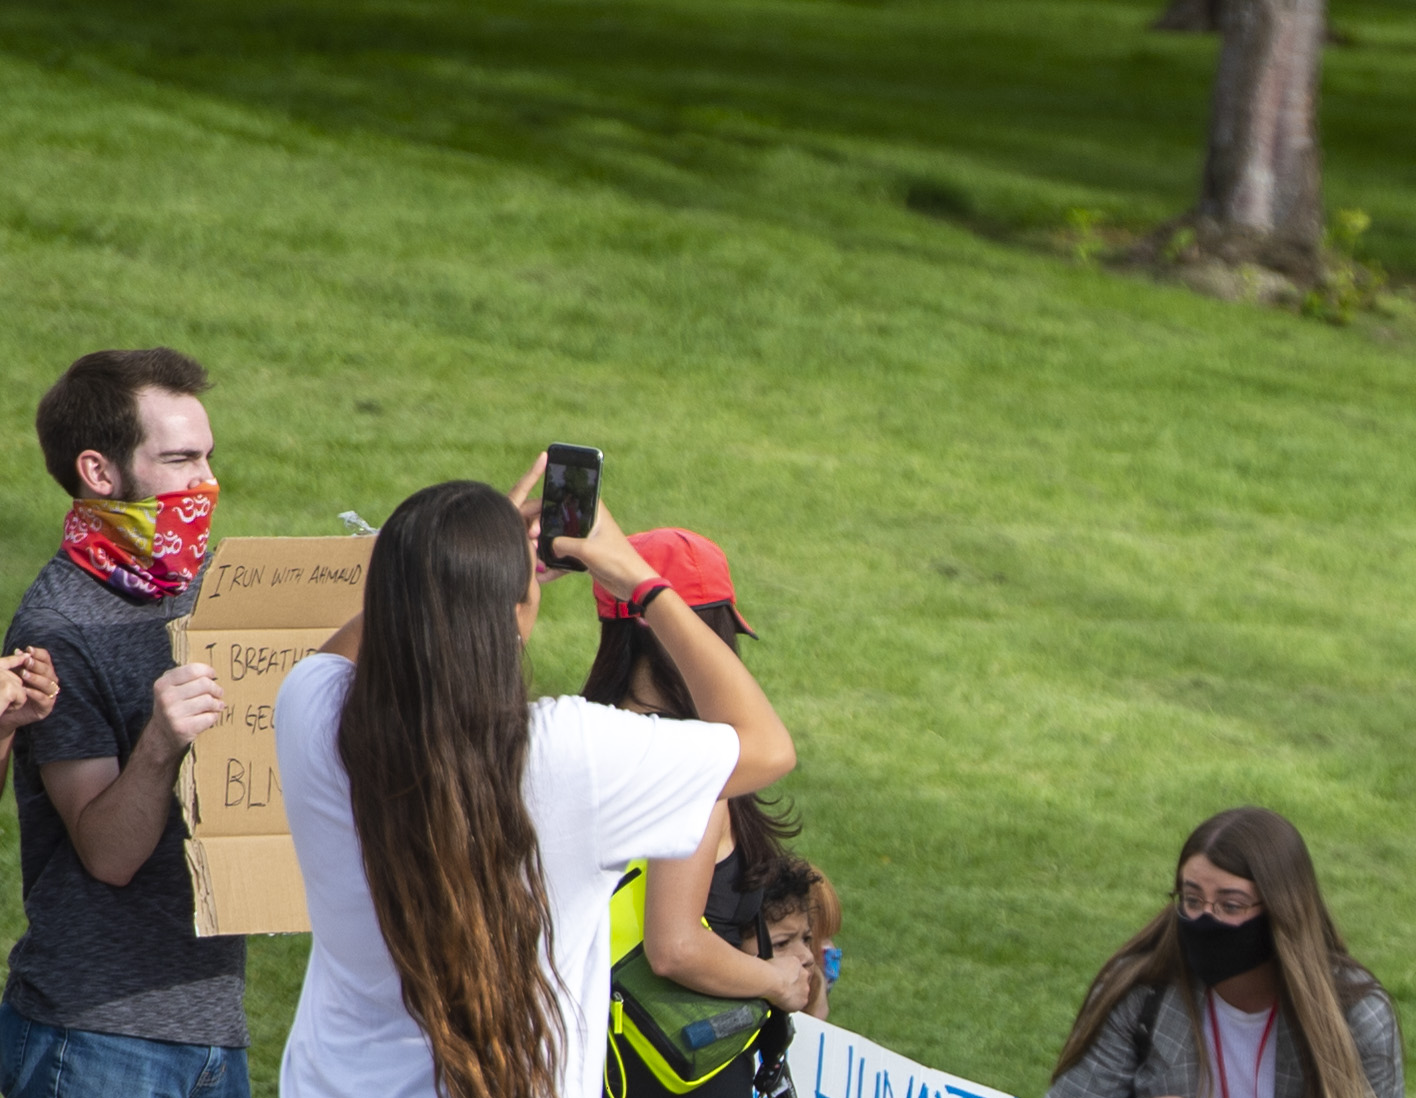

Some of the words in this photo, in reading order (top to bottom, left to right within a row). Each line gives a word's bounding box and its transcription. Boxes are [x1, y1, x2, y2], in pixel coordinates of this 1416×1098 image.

[208, 564, 231, 599] I
[229, 565, 266, 592] RUN
[271, 566, 306, 587] WITH
[308, 564, 363, 585] AHMAUD
[231, 643, 318, 682] BREATH
